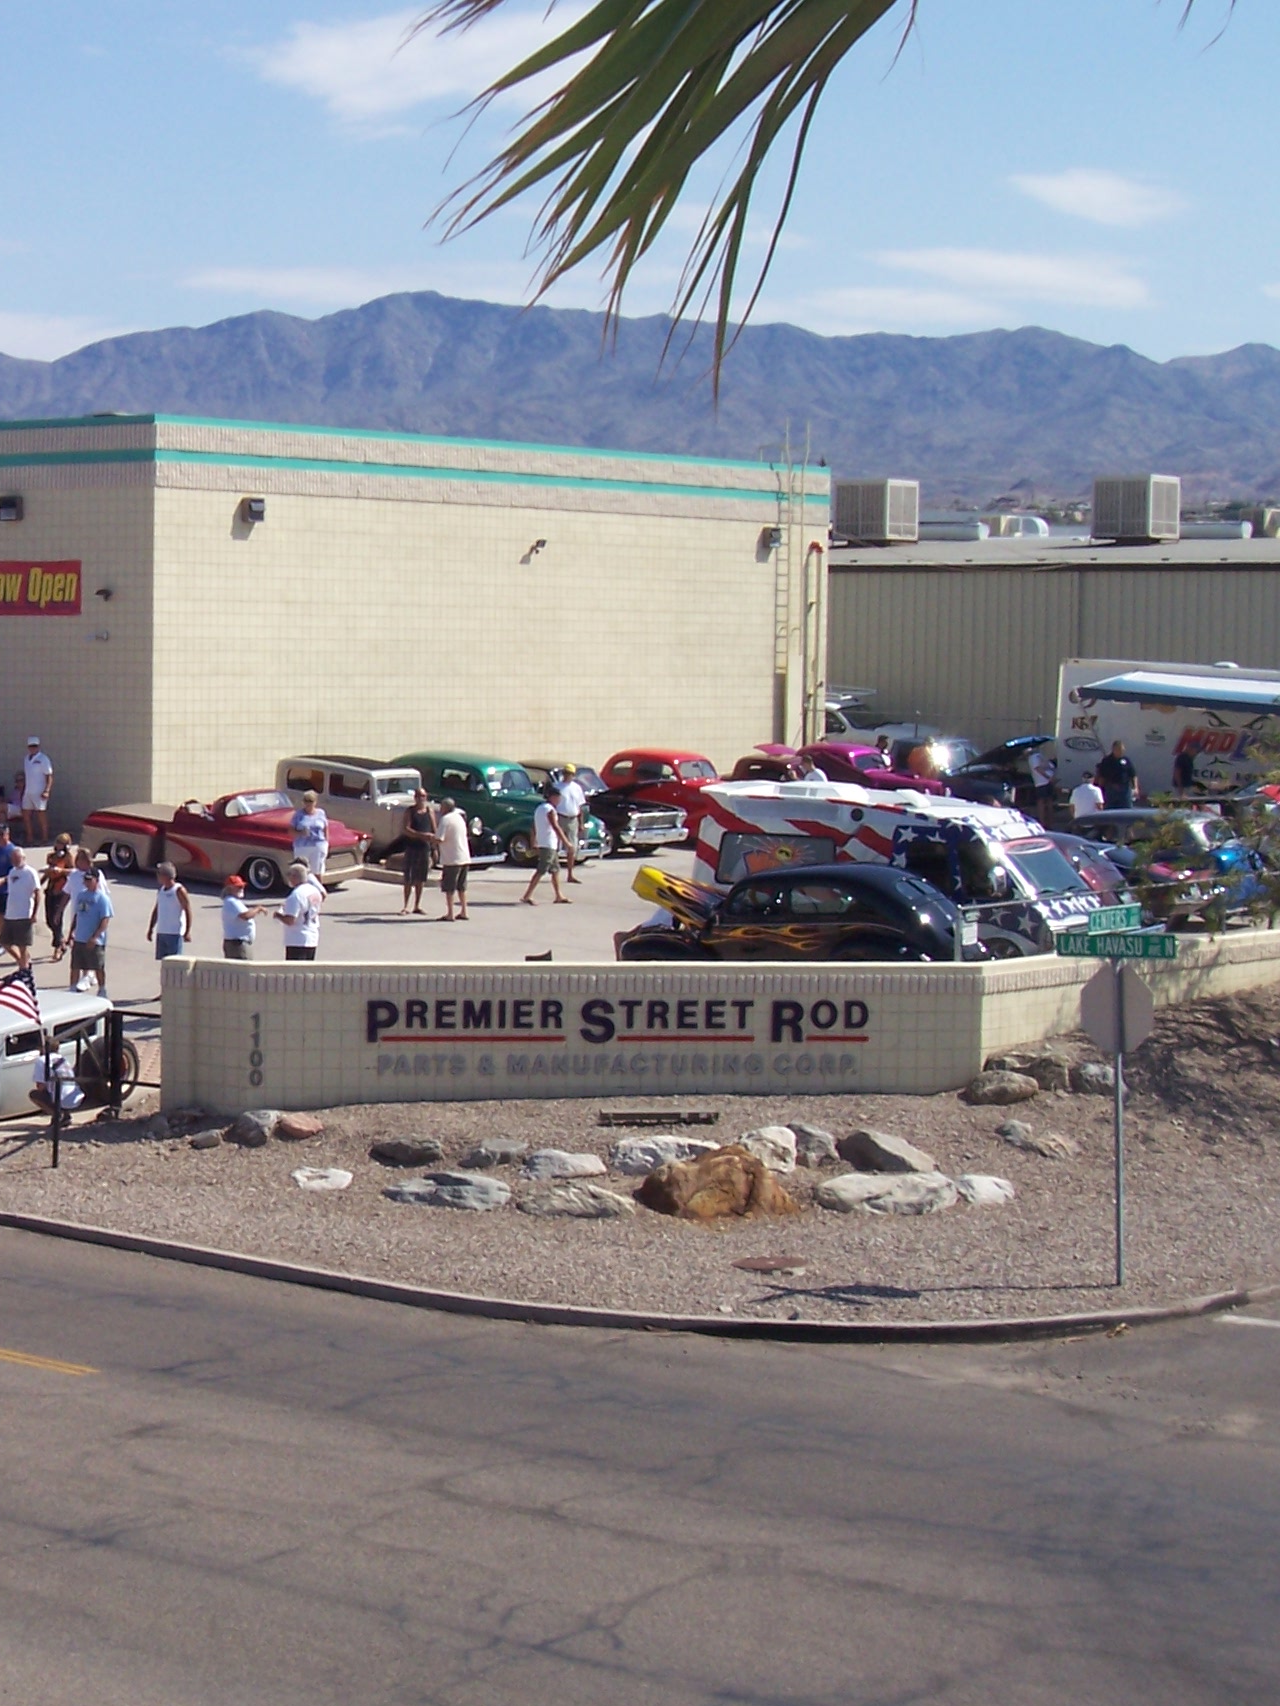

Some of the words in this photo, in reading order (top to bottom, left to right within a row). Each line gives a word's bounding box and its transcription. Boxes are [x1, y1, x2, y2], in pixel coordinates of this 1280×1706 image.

[27, 566, 78, 609] Open
[1090, 908, 1127, 930] CENTERS
[1060, 935, 1091, 954] LAKE
[1097, 936, 1143, 956] HAVASU
[1165, 937, 1174, 957] N
[366, 999, 564, 1043] PREMIER
[579, 999, 755, 1044] STREET
[771, 999, 870, 1043] ROD
[249, 1012, 263, 1088] 1100
[376, 1054, 467, 1077] PARTS
[477, 1054, 496, 1076] &
[506, 1053, 765, 1076] MANUFACTURING
[773, 1053, 858, 1076] CORP.
